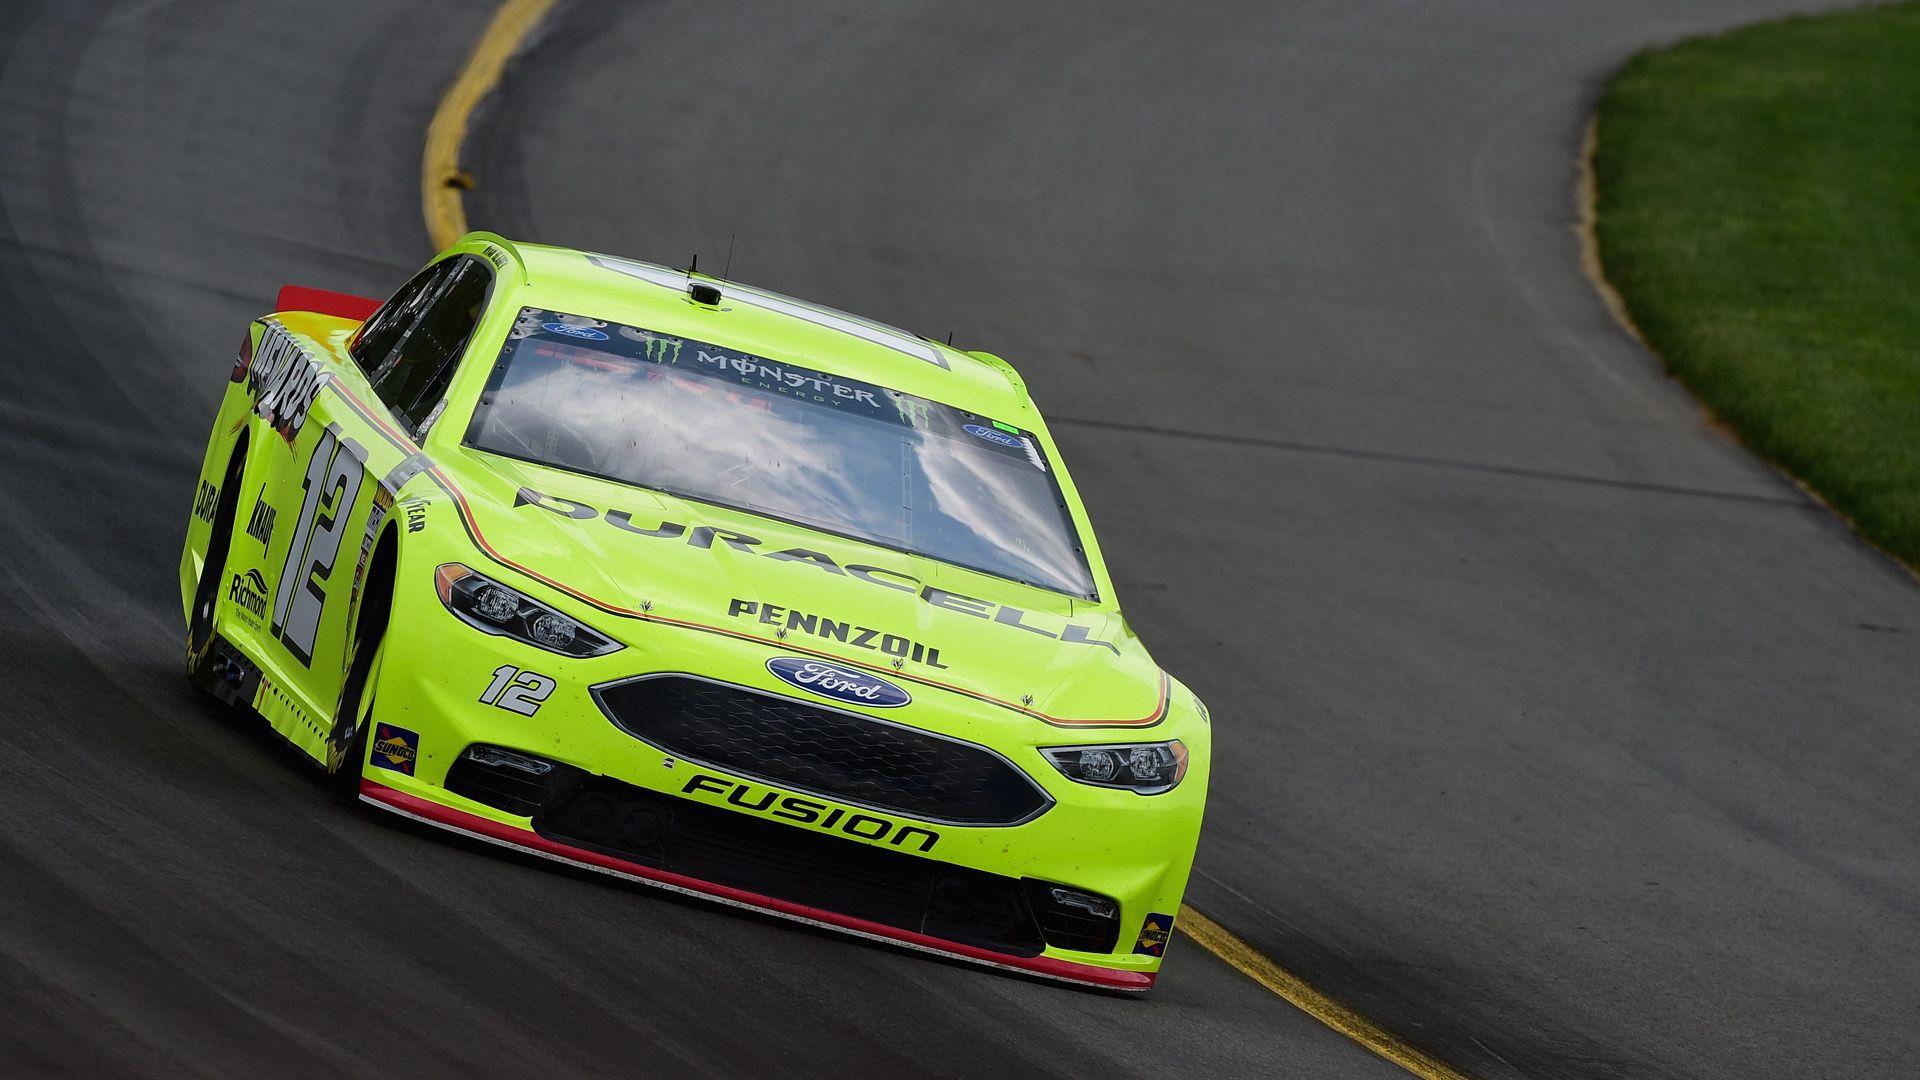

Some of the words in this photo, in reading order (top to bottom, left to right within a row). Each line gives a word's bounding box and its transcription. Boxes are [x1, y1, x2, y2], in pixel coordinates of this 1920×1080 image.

[553, 324, 597, 338] Ford
[696, 349, 882, 408] MONSTER
[740, 377, 841, 406] ENERGY
[975, 426, 1012, 446] Ford
[269, 420, 369, 671] 12
[512, 485, 1122, 658] DURACELL
[228, 573, 269, 621] Richmond
[727, 598, 950, 670] PENNZOIL
[478, 664, 557, 717] 12
[794, 662, 883, 700] Ford
[374, 739, 416, 762] SUNOCO
[681, 774, 940, 852] FUSION
